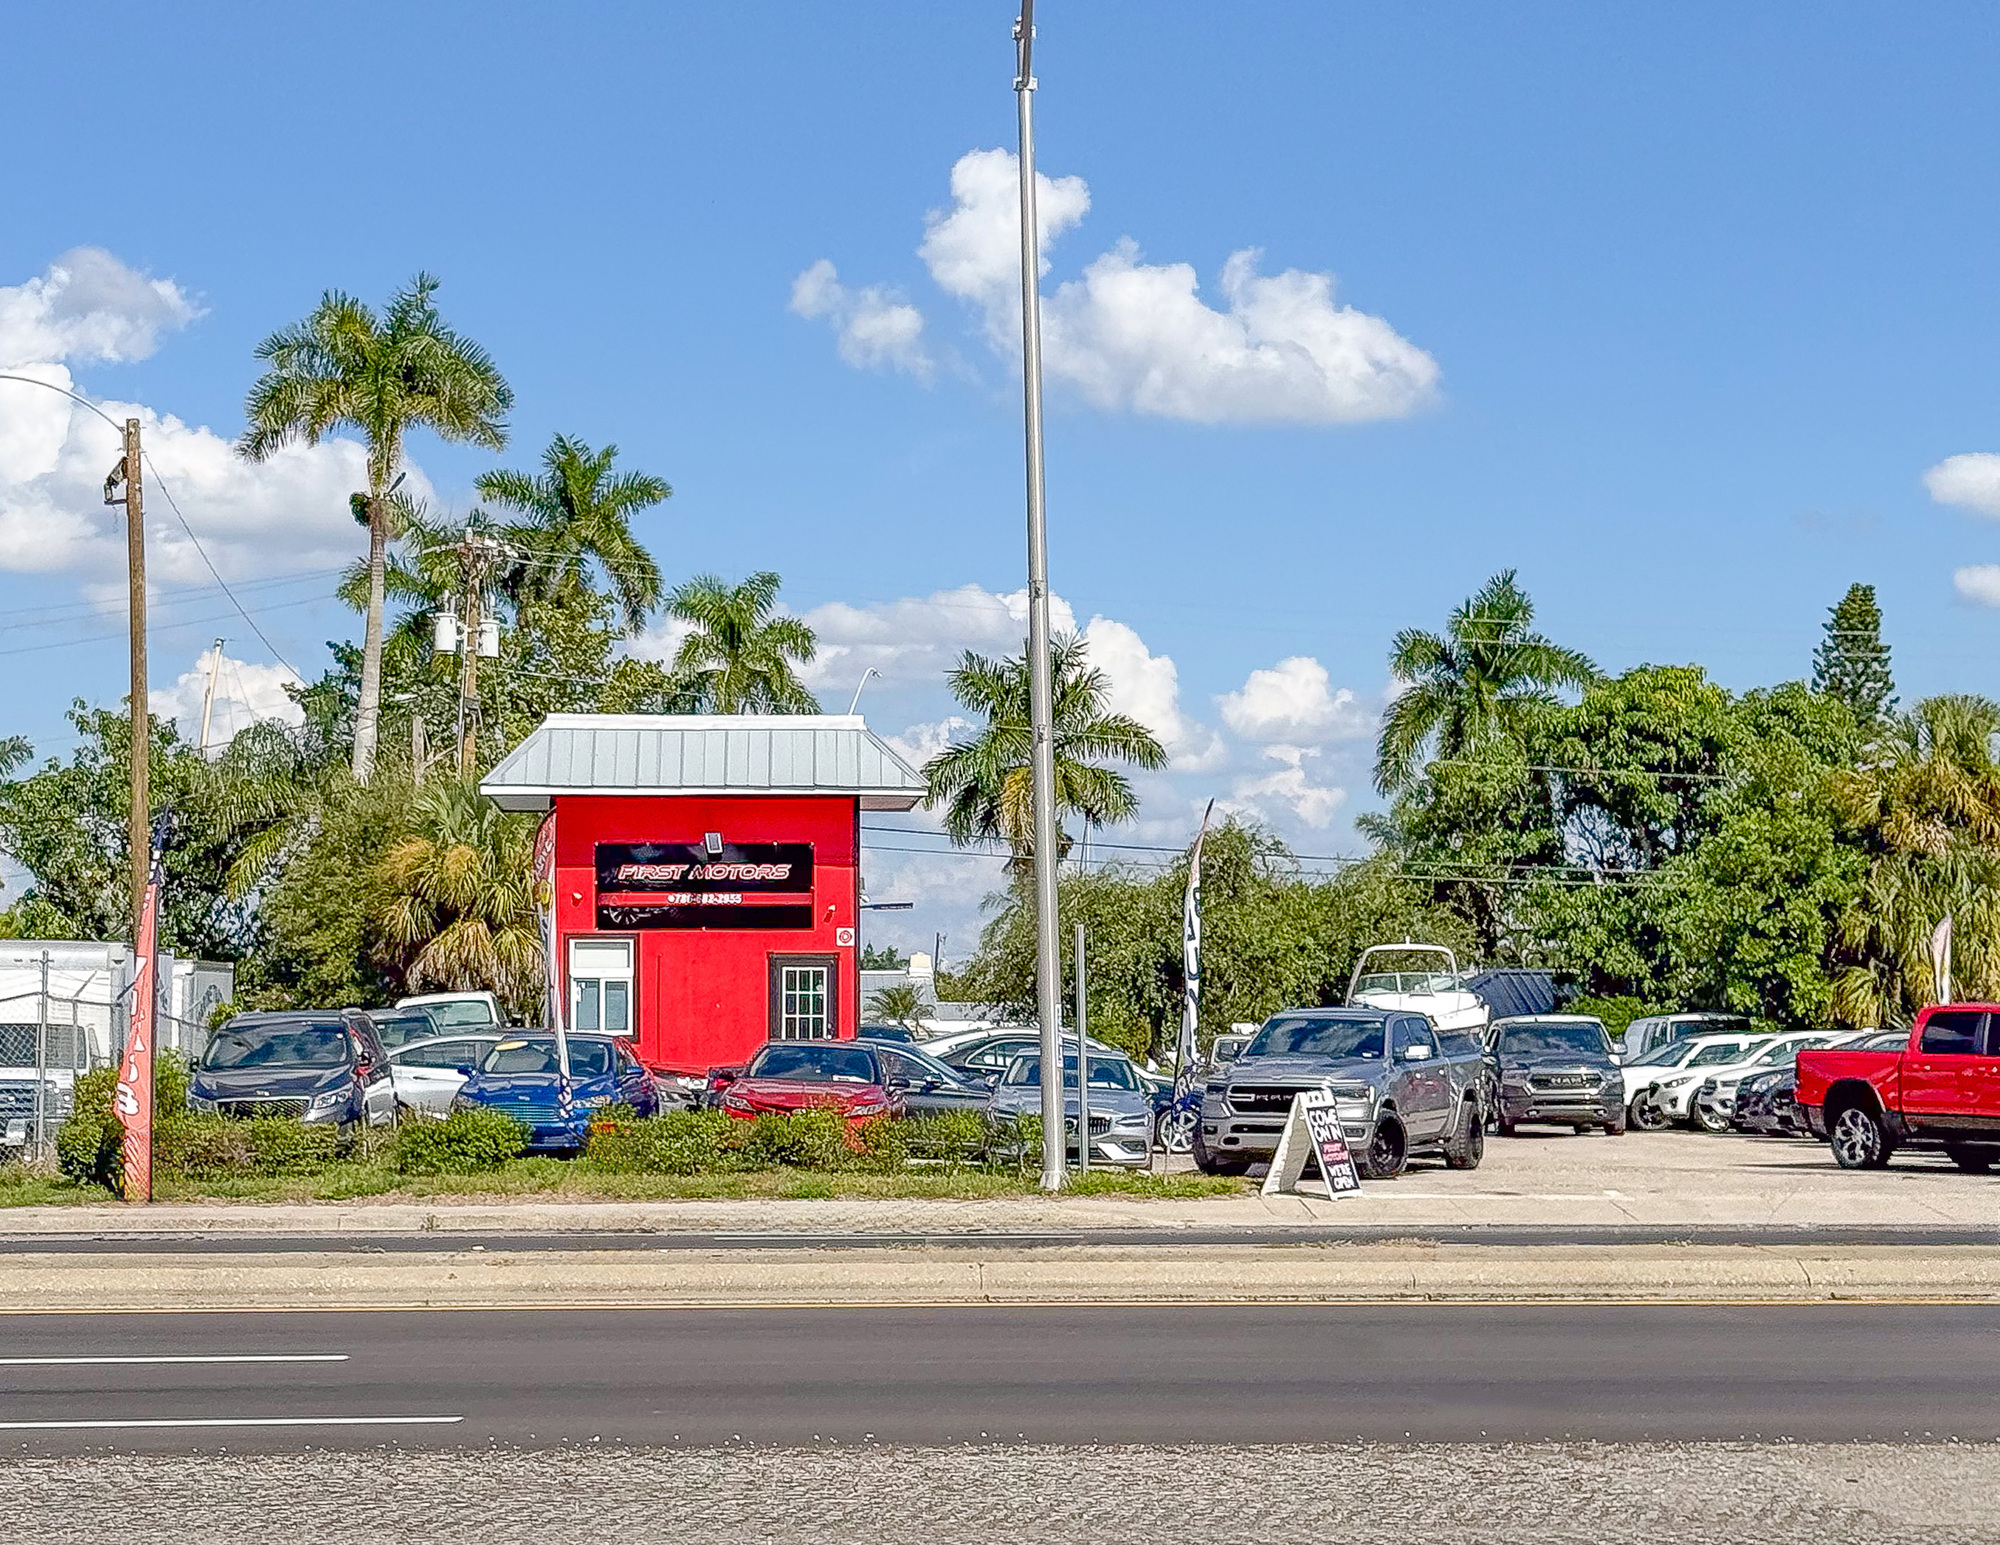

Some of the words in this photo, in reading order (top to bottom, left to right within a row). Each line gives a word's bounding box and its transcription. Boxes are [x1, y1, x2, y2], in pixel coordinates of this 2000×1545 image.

[617, 864, 689, 880] FIRST
[688, 864, 792, 880] MOTORS
[1309, 1109, 1339, 1127] COME
[1313, 1126, 1332, 1143] ON
[1329, 1124, 1343, 1141] IN
